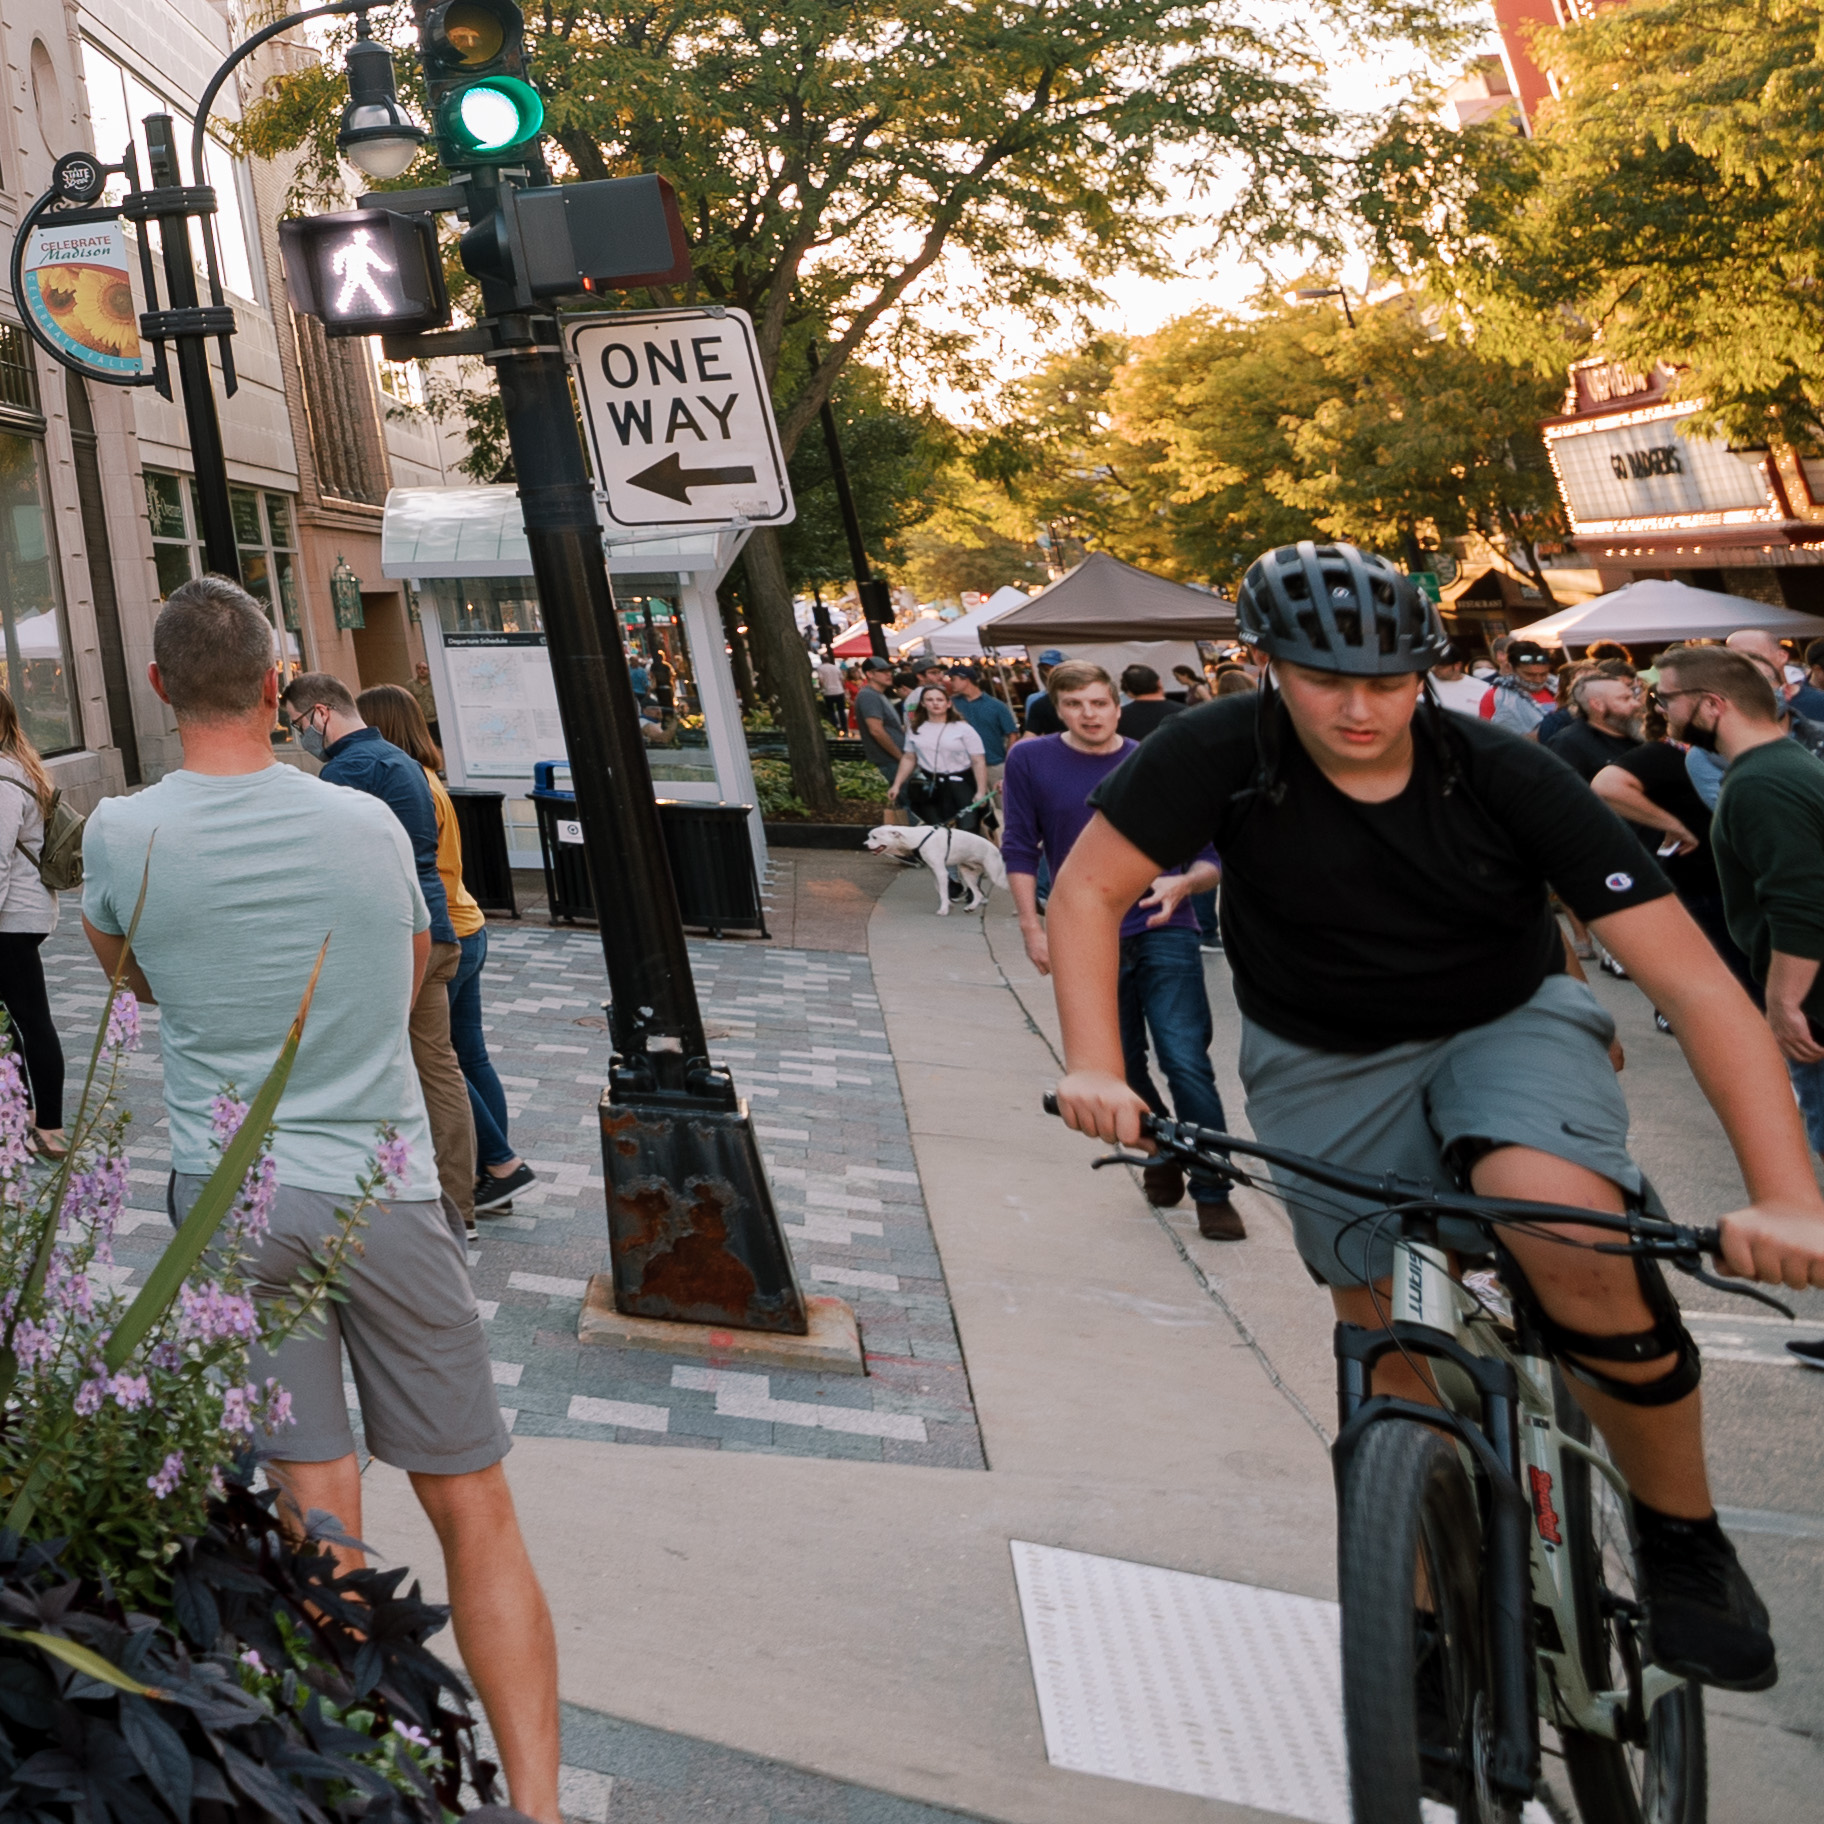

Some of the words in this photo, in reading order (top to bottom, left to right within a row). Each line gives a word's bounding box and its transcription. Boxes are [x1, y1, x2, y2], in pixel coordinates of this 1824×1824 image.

[39, 247, 111, 265] Madison
[40, 235, 112, 252] CELEBRATE
[28, 275, 78, 351] CELEBRATE
[87, 352, 125, 368] FALL
[600, 335, 733, 389] ONE
[606, 393, 739, 446] WAY
